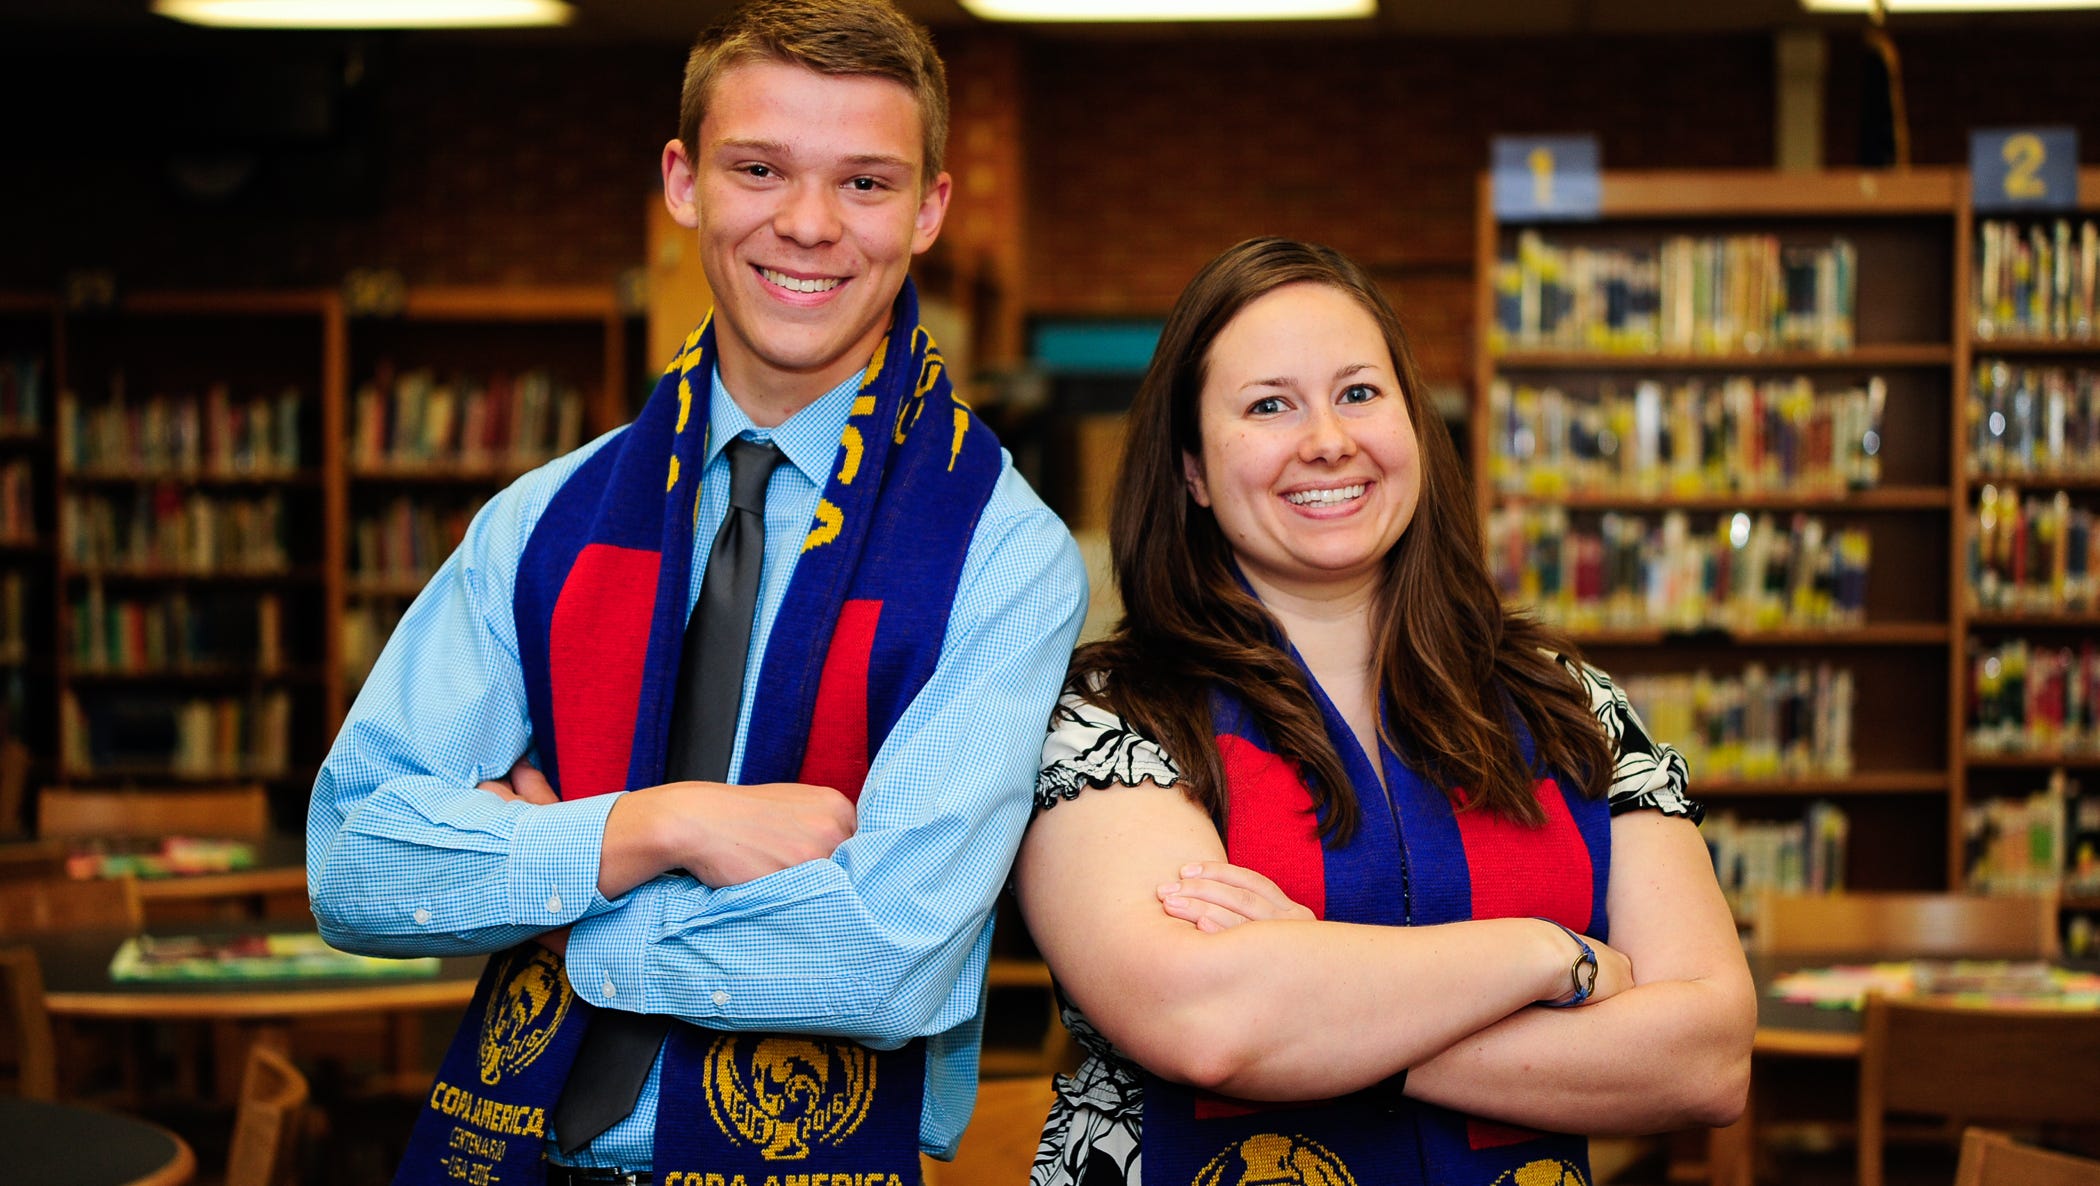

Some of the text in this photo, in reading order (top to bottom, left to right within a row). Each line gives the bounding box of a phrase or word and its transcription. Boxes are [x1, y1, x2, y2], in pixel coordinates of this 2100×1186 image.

[1528, 147, 1554, 206] 1
[2001, 132, 2046, 199] 2
[430, 1081, 545, 1138] COPA AMERICA
[802, 1092, 844, 1139] 2016
